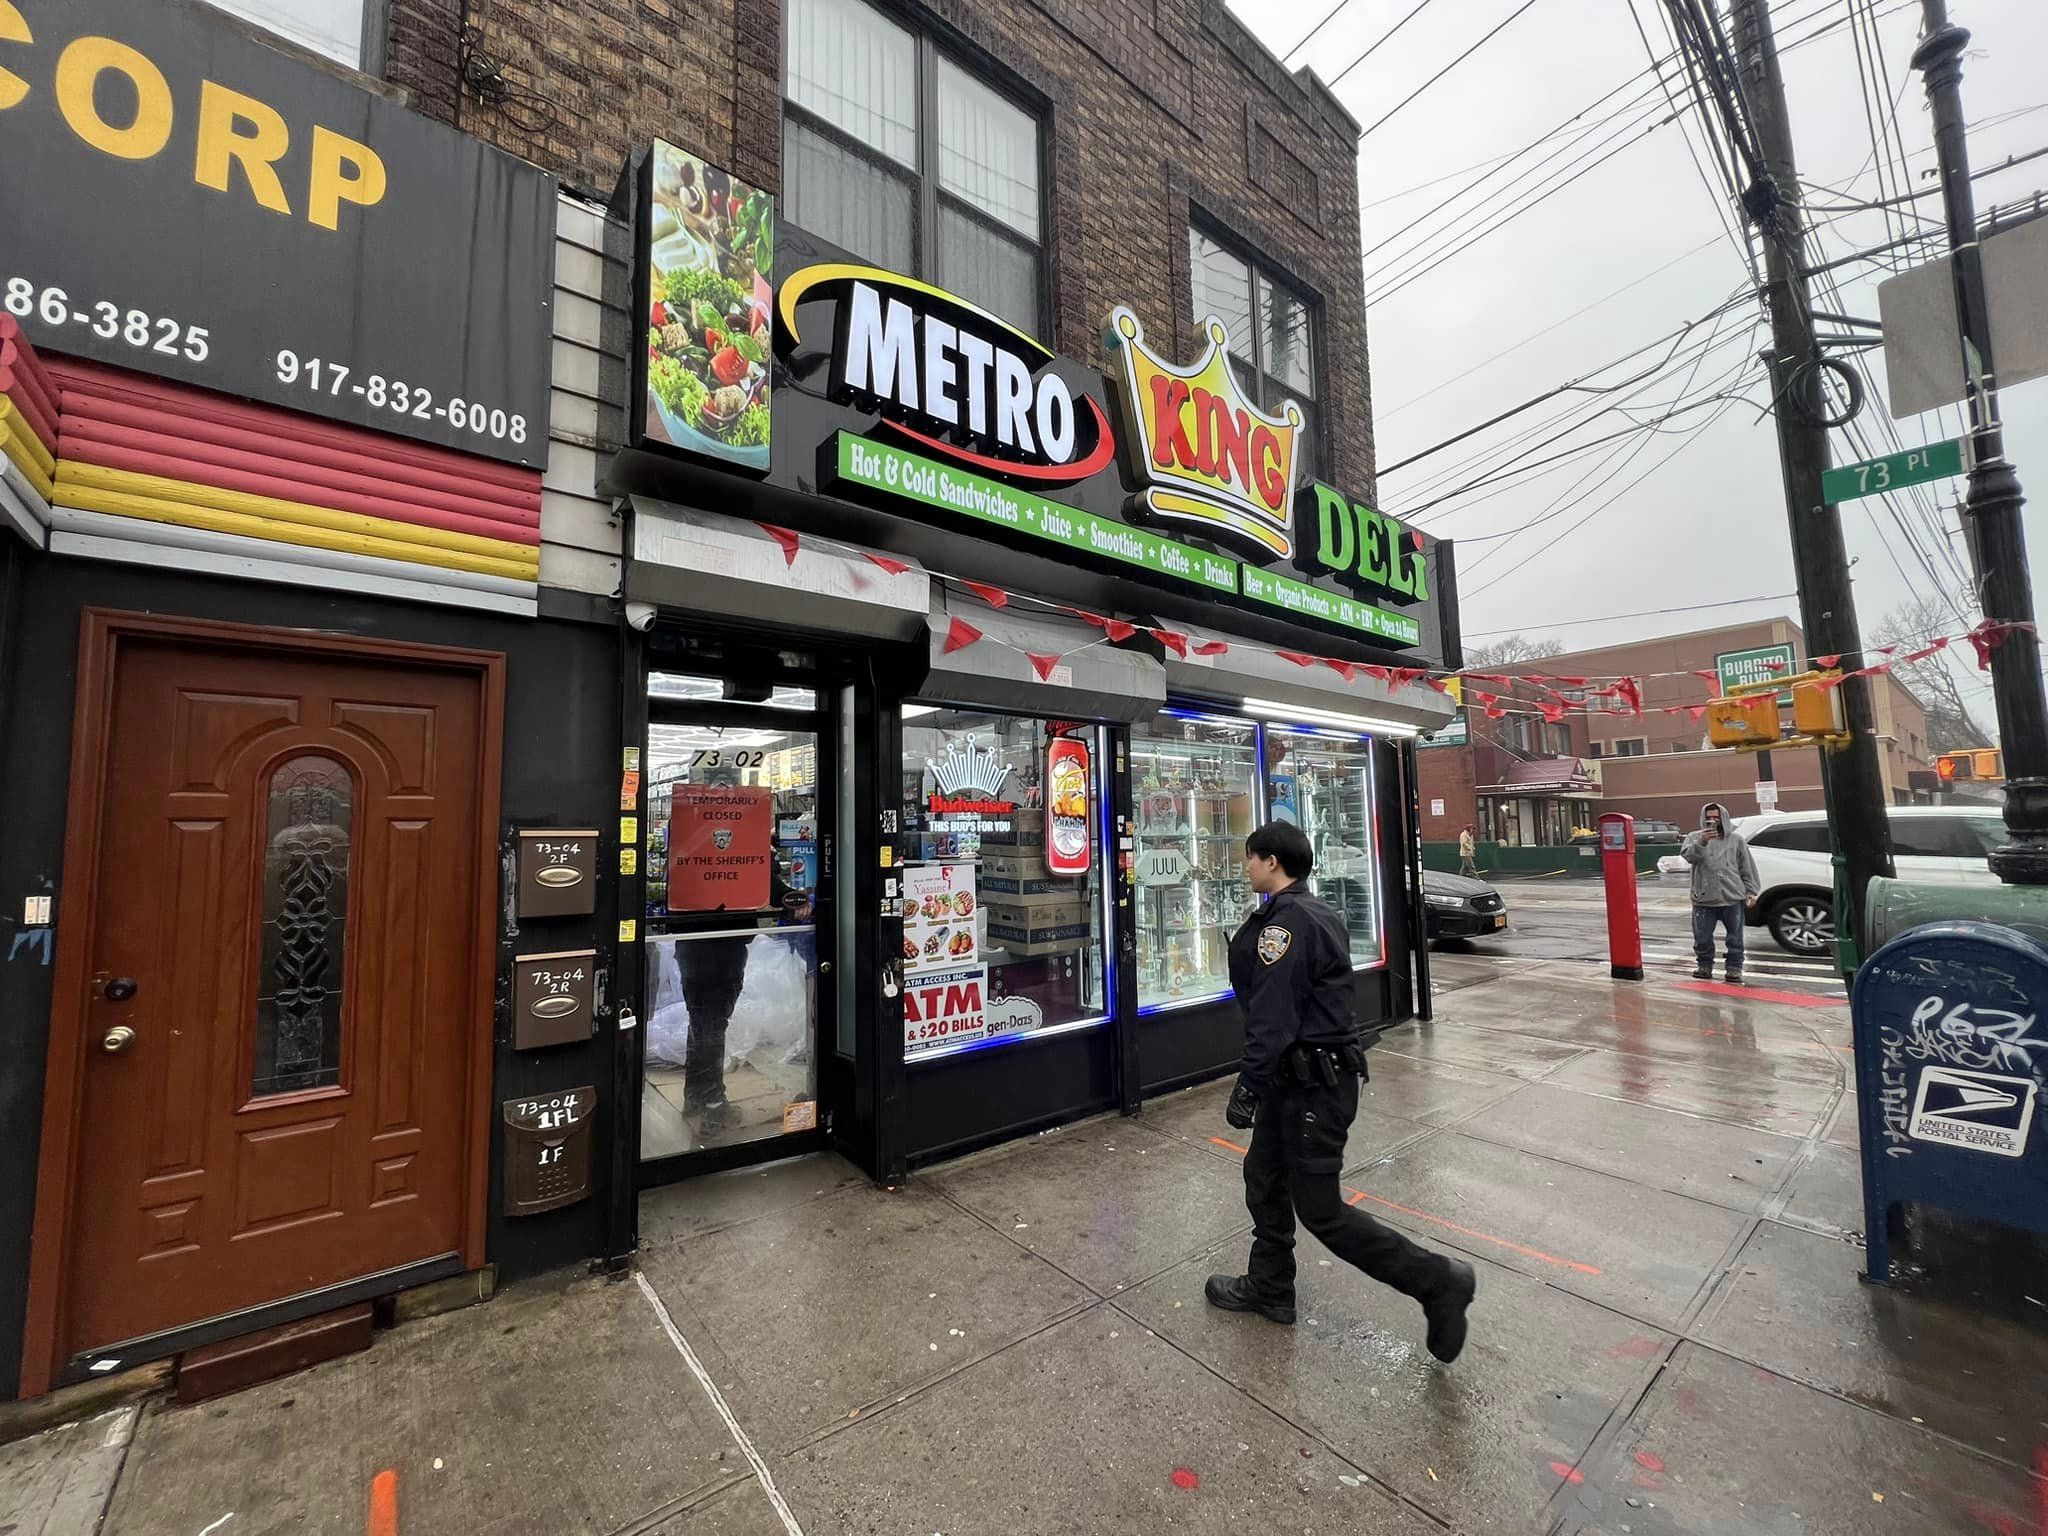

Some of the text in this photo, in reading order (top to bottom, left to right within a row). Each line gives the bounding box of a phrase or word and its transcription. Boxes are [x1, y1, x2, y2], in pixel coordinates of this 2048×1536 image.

[845, 280, 1076, 464] METRO
[276, 349, 528, 444] 917-832-6008
[1150, 374, 1286, 508] KING
[1854, 461, 1891, 492] 73
[851, 443, 1234, 588] Hot & Cold Sandwiches Juice Smoothies Coffee Drinks
[1245, 571, 1263, 596] Beer
[1275, 580, 1303, 609] Organic
[1302, 589, 1330, 616] Products
[1340, 602, 1354, 623] ATM
[1380, 614, 1396, 637] Open
[691, 749, 764, 768] 73-02
[685, 795, 760, 806] TEMPORARILY
[929, 795, 1013, 814] Budweiser
[703, 811, 742, 820] CLOSED
[929, 821, 1011, 832] THIS BUD'S FOR YOU
[535, 843, 581, 855] 73-04
[550, 853, 568, 864] 2F
[792, 846, 815, 854] PULL
[824, 838, 832, 873] PULL
[676, 855, 765, 866] BY THE SHERIFF'S
[1151, 856, 1178, 876] JUUL
[703, 871, 739, 881] OFFICE
[532, 967, 584, 986] 73-04
[905, 979, 922, 988] ATM
[923, 974, 951, 985] ACCESS
[550, 980, 570, 993] 2R
[904, 982, 982, 1023] ATM
[907, 1015, 984, 1041] & $20 BILLS
[517, 1094, 579, 1116] 73-04
[537, 1109, 579, 1129] 1FL
[1918, 1126, 2017, 1151] POSTAL SERVICE
[1919, 1118, 2012, 1141] UNITED STATES
[538, 1147, 564, 1165] 1F
